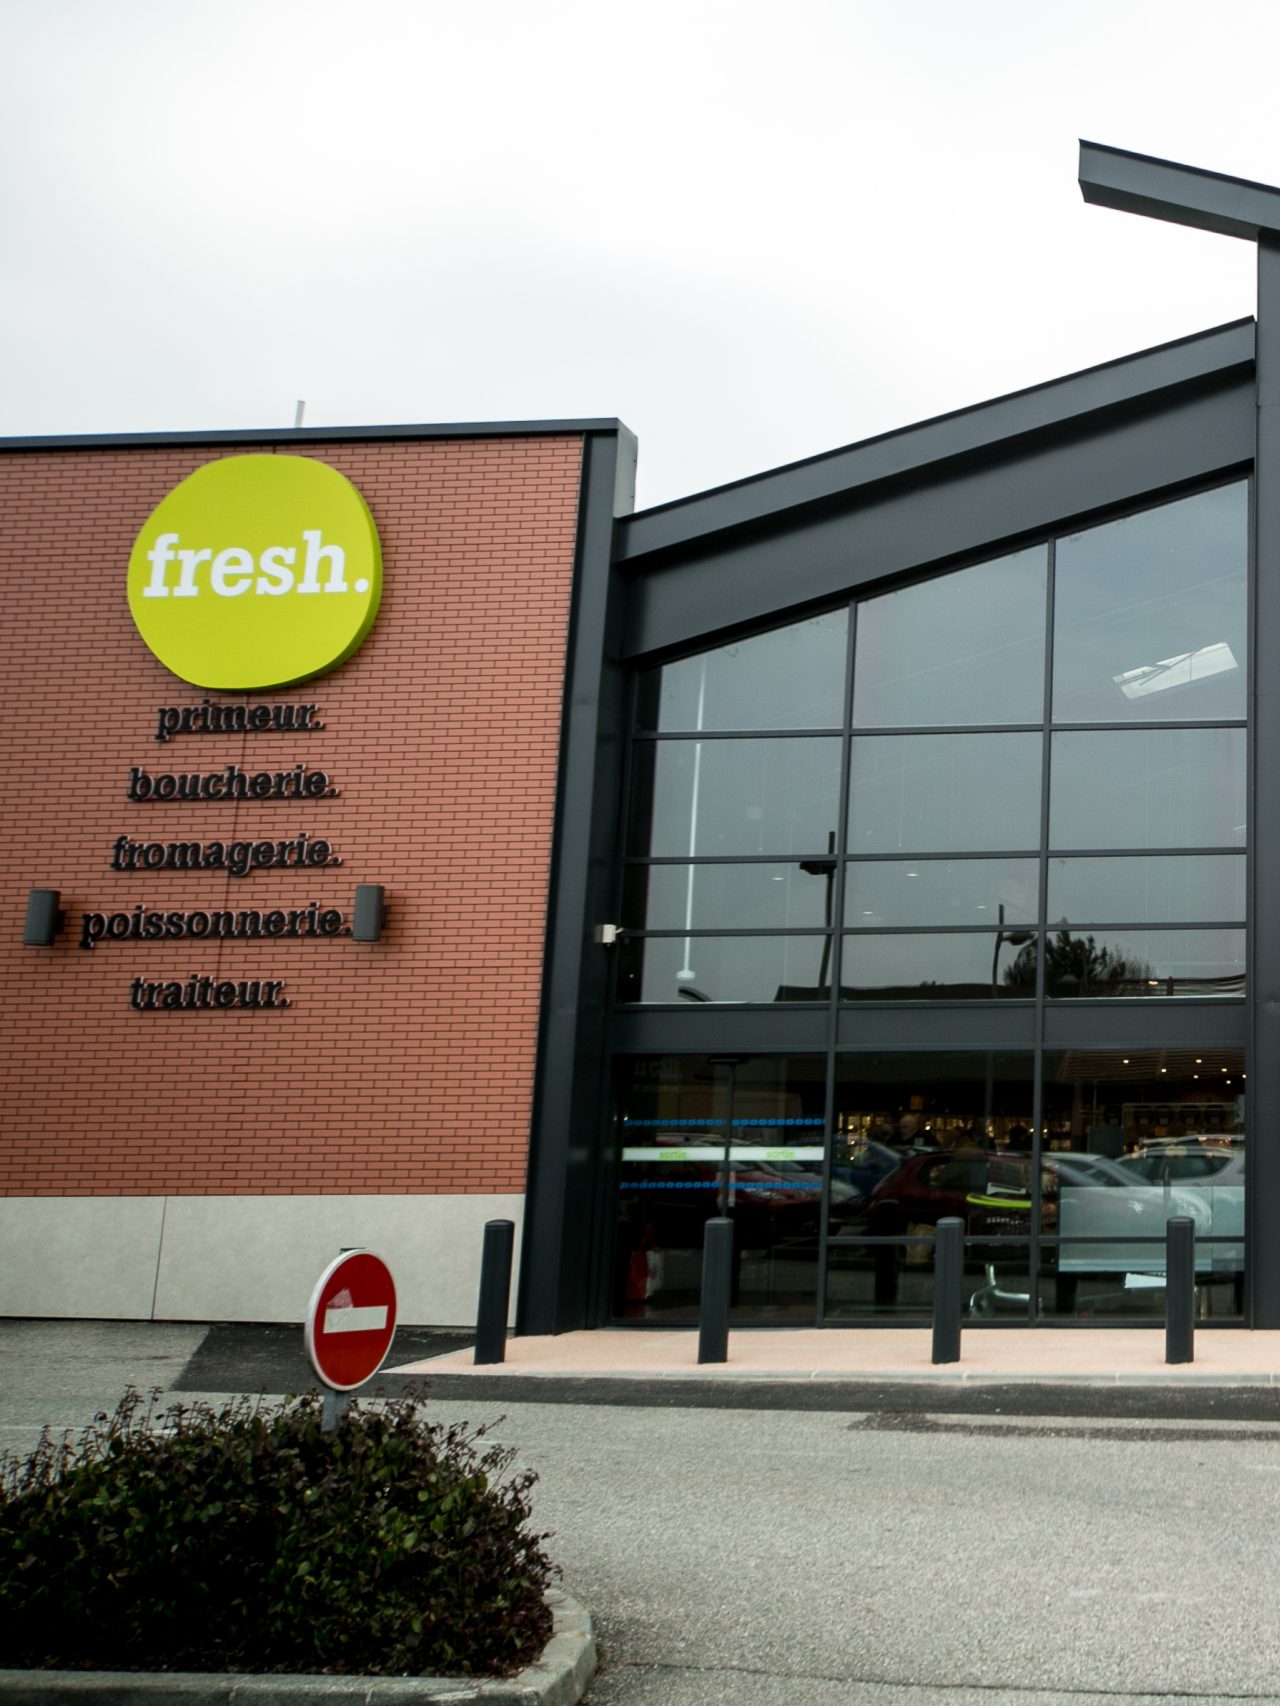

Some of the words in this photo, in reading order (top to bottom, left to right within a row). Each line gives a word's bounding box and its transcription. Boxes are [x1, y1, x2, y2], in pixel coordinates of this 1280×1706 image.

[142, 530, 370, 598] fresh.
[154, 699, 325, 742] primeur.
[126, 764, 340, 801] boucherie.
[110, 832, 343, 877] fromagerie.
[79, 901, 354, 949] poissonnerie.
[130, 974, 292, 1010] traiteur.
